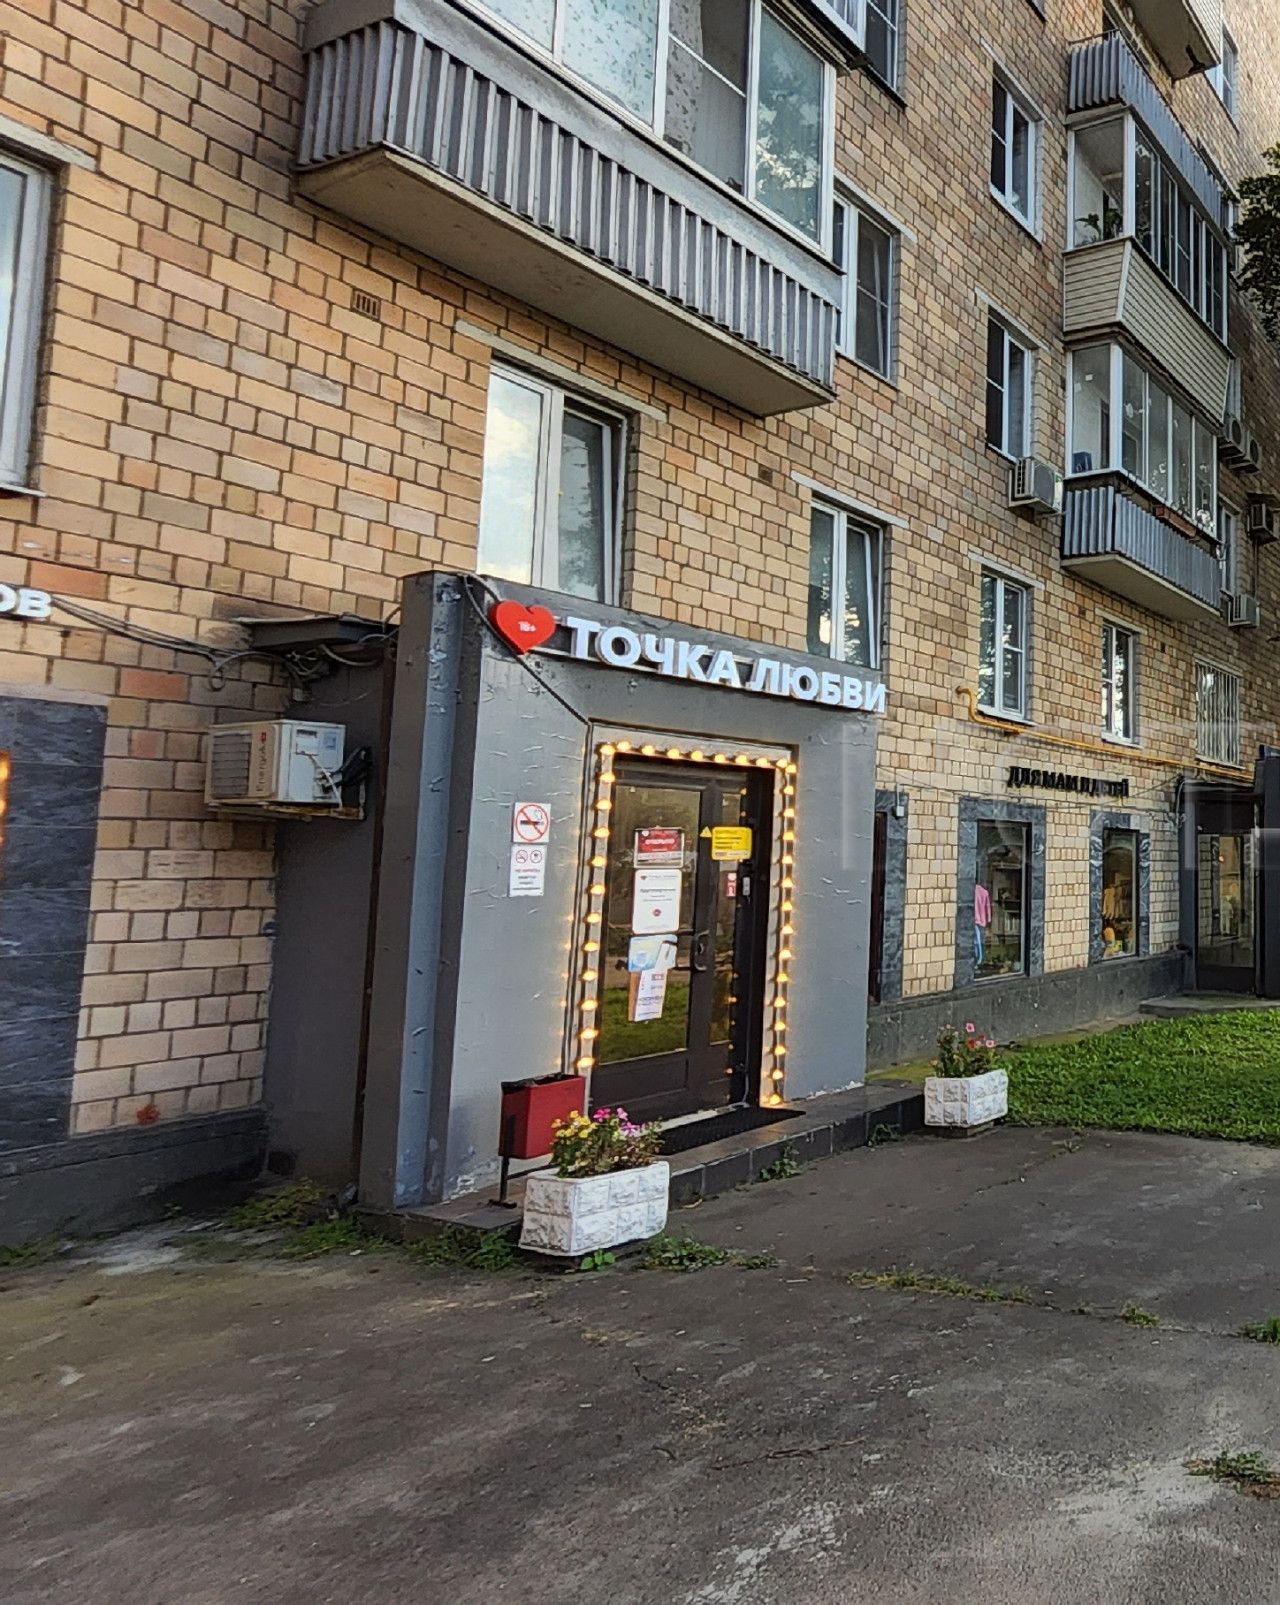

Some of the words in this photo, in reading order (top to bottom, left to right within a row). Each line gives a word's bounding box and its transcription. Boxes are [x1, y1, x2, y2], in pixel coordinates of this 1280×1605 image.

[566, 616, 742, 688] ТОЧКА
[746, 658, 886, 713] ЛЮБВИ
[1007, 765, 1041, 788] ДЛЯ
[1042, 770, 1079, 793] МАМ
